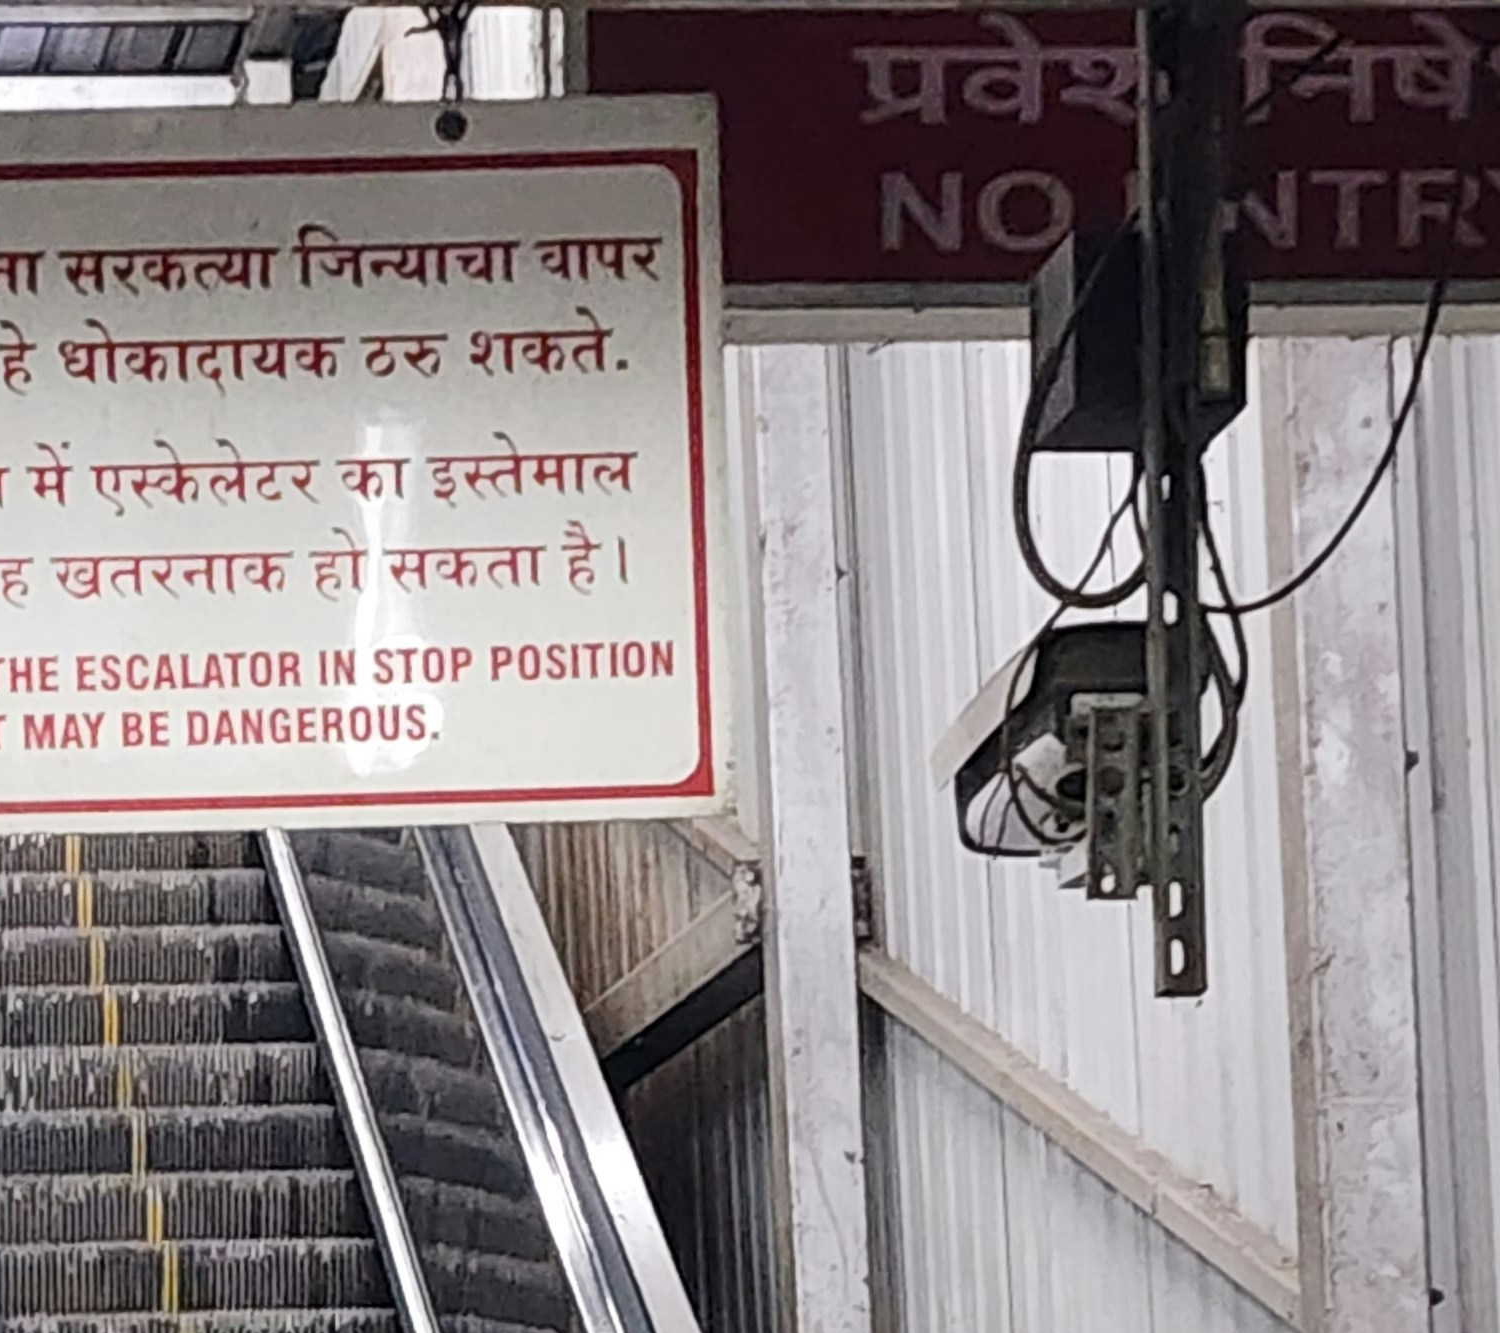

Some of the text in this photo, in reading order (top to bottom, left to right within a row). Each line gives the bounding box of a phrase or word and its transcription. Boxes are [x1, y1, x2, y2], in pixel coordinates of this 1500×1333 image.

[1242, 11, 1500, 124] निषे
[880, 168, 1500, 250] NO NTR
[58, 247, 279, 295] सरकत्या
[291, 224, 520, 287] जिन्याचा
[533, 237, 662, 280] वापर
[58, 318, 345, 397] धोकादायक
[470, 306, 628, 376] शकते.
[26, 442, 73, 507] में
[90, 439, 320, 517] एस्केलेटर
[335, 458, 410, 499] का
[426, 432, 638, 508] इस्तेमाल
[50, 551, 293, 599] खतरनाक
[308, 527, 368, 602] हो
[383, 546, 547, 592] सकता
[76, 651, 301, 692] ESCALATOR
[319, 649, 355, 686] IN
[373, 647, 472, 684] STOP
[490, 640, 673, 681] POSITION
[23, 712, 105, 750] MAY
[122, 711, 169, 747] BE
[187, 705, 439, 746] DANGEROUS.
